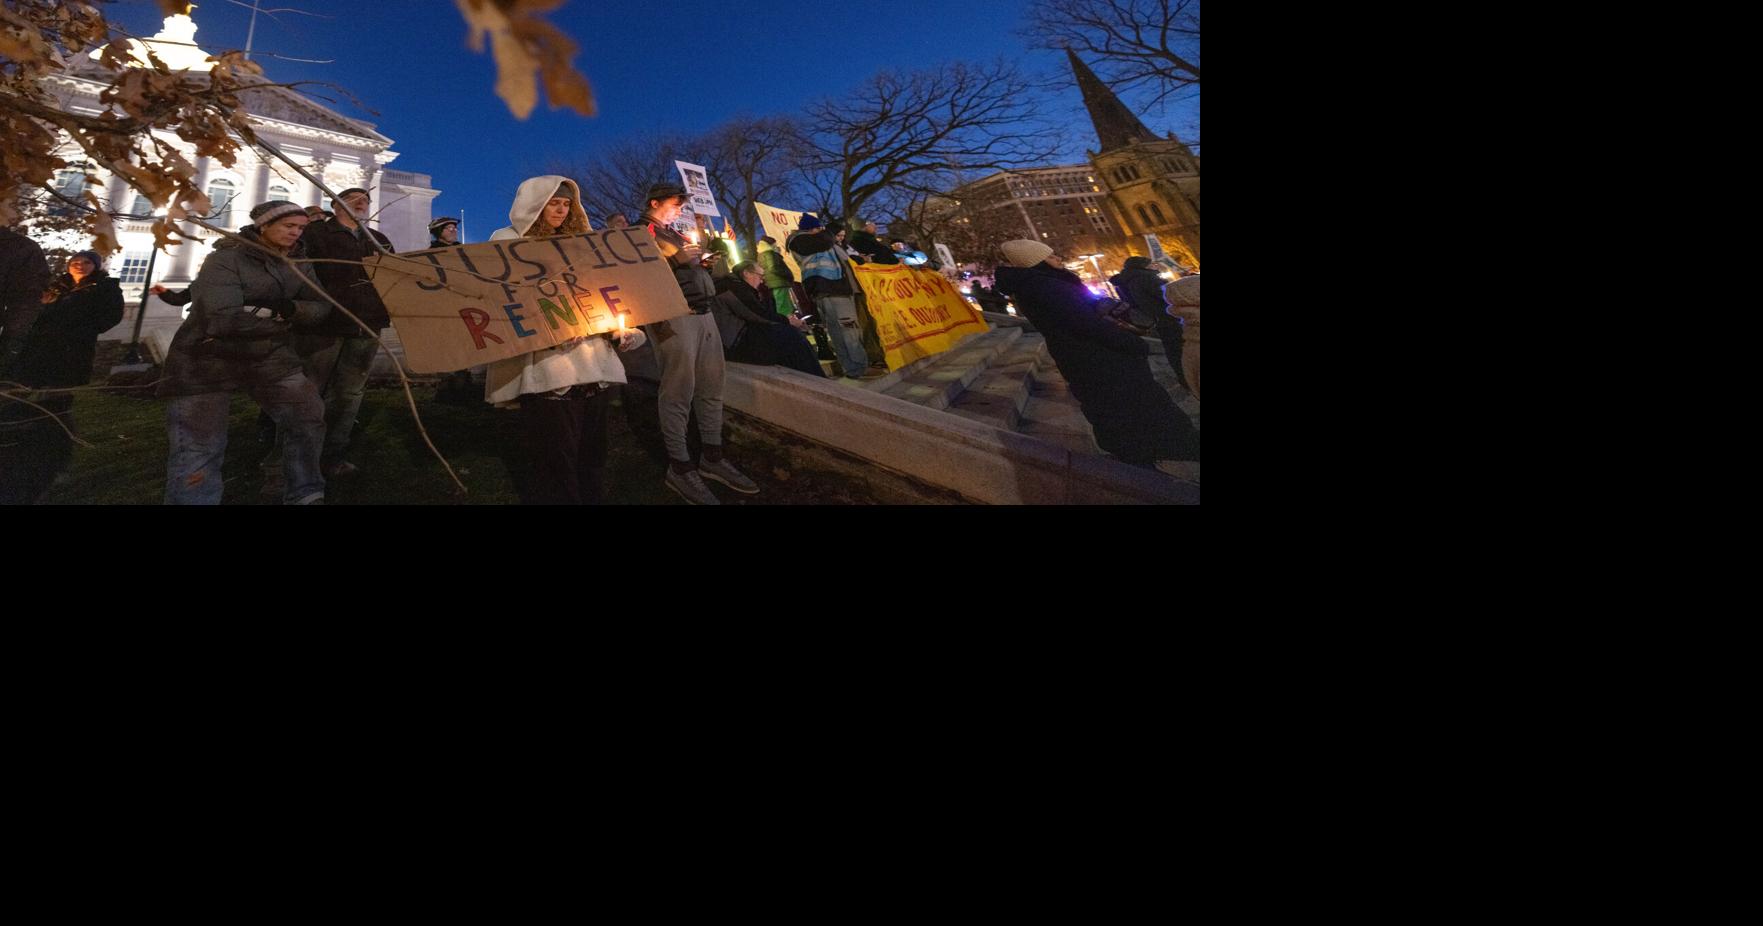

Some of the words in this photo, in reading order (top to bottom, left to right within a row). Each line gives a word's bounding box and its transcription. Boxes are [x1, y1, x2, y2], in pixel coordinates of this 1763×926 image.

[770, 211, 788, 225] NO
[406, 226, 660, 291] JUSTICE
[500, 272, 593, 303] FOR
[458, 285, 631, 350] RENEE
